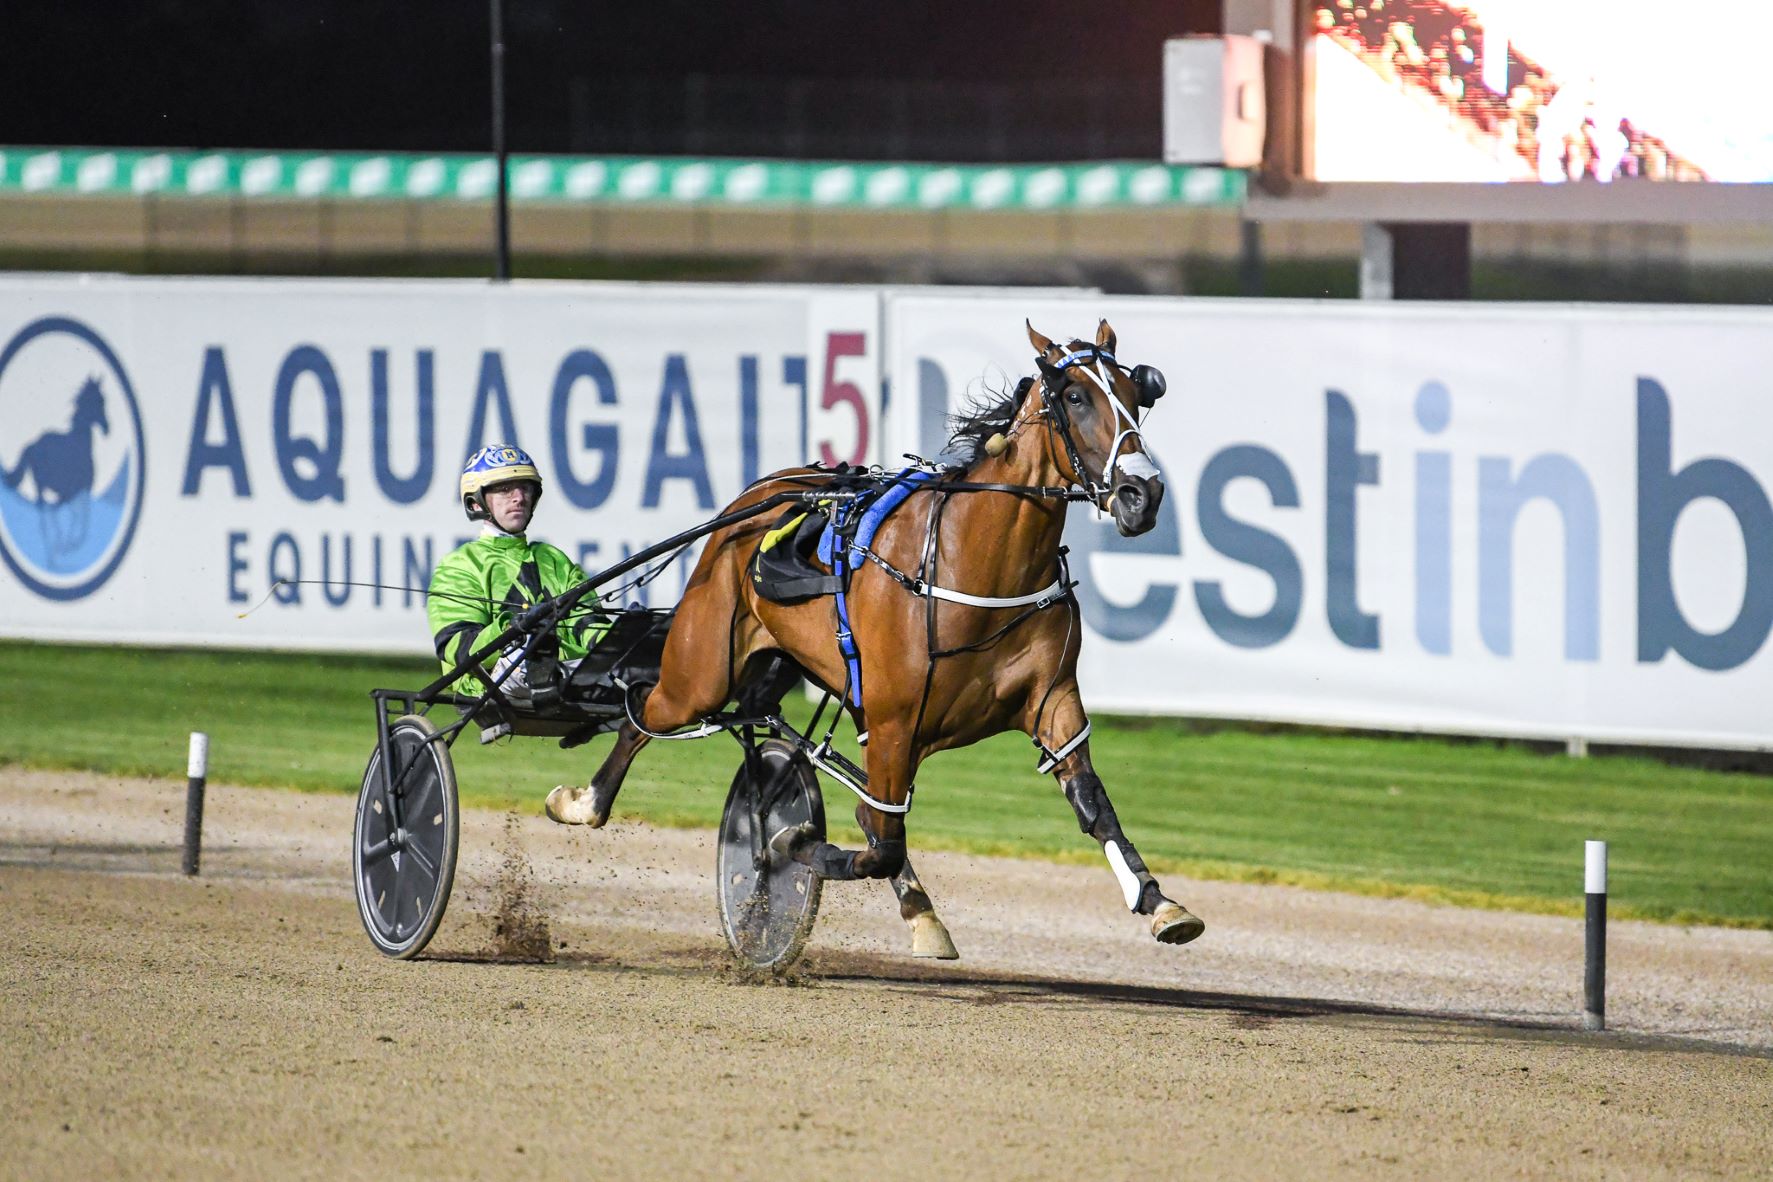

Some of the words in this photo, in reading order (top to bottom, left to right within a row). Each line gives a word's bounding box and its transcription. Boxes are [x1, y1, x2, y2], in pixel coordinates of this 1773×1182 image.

[818, 330, 869, 468] 5
[227, 531, 478, 608] EQUIN
[917, 356, 1773, 673] estinb
